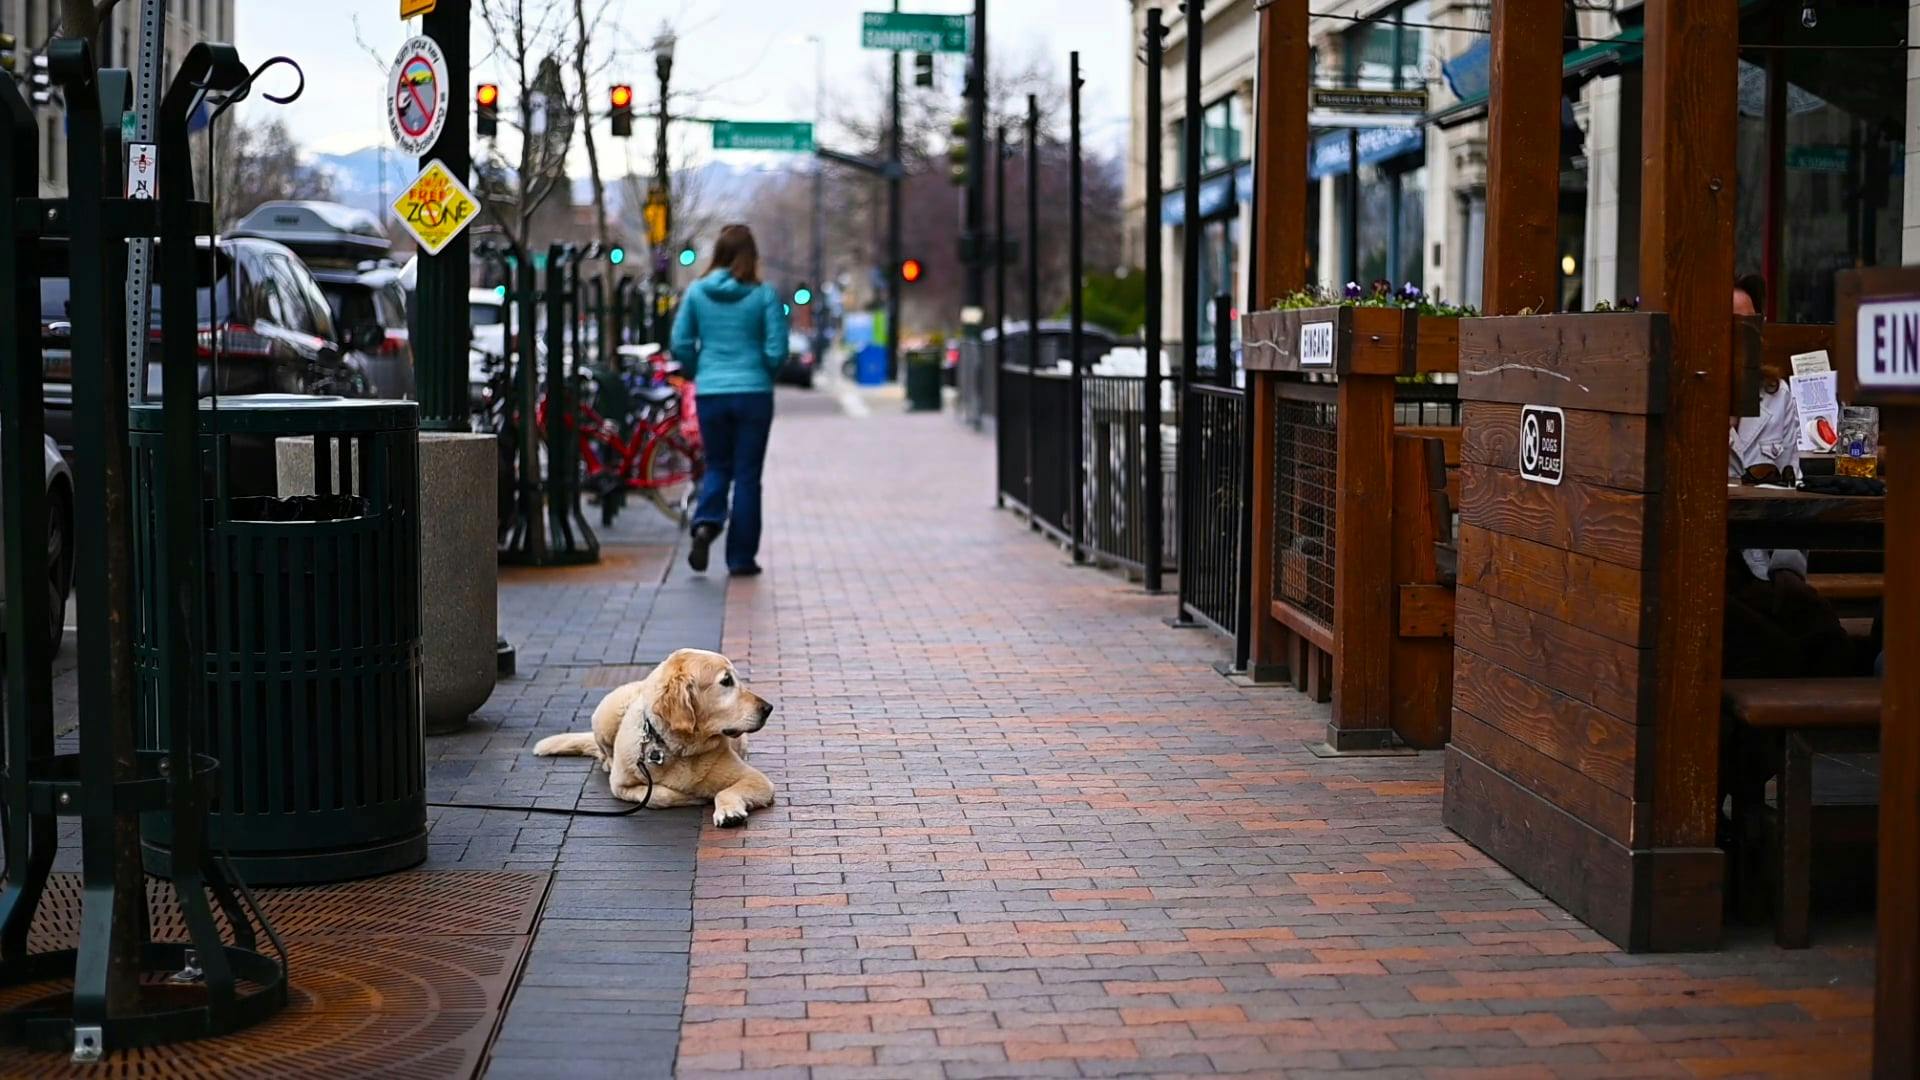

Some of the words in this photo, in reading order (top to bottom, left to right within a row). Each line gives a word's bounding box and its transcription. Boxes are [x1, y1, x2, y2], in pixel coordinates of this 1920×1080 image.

[409, 188, 447, 201] FREE
[407, 200, 468, 227] ZONE
[1303, 328, 1330, 358] EINGANG
[1874, 313, 1919, 374] EIN
[1545, 419, 1555, 434] NO
[1541, 437, 1558, 453] DOGS
[1538, 455, 1561, 473] PLEASE
